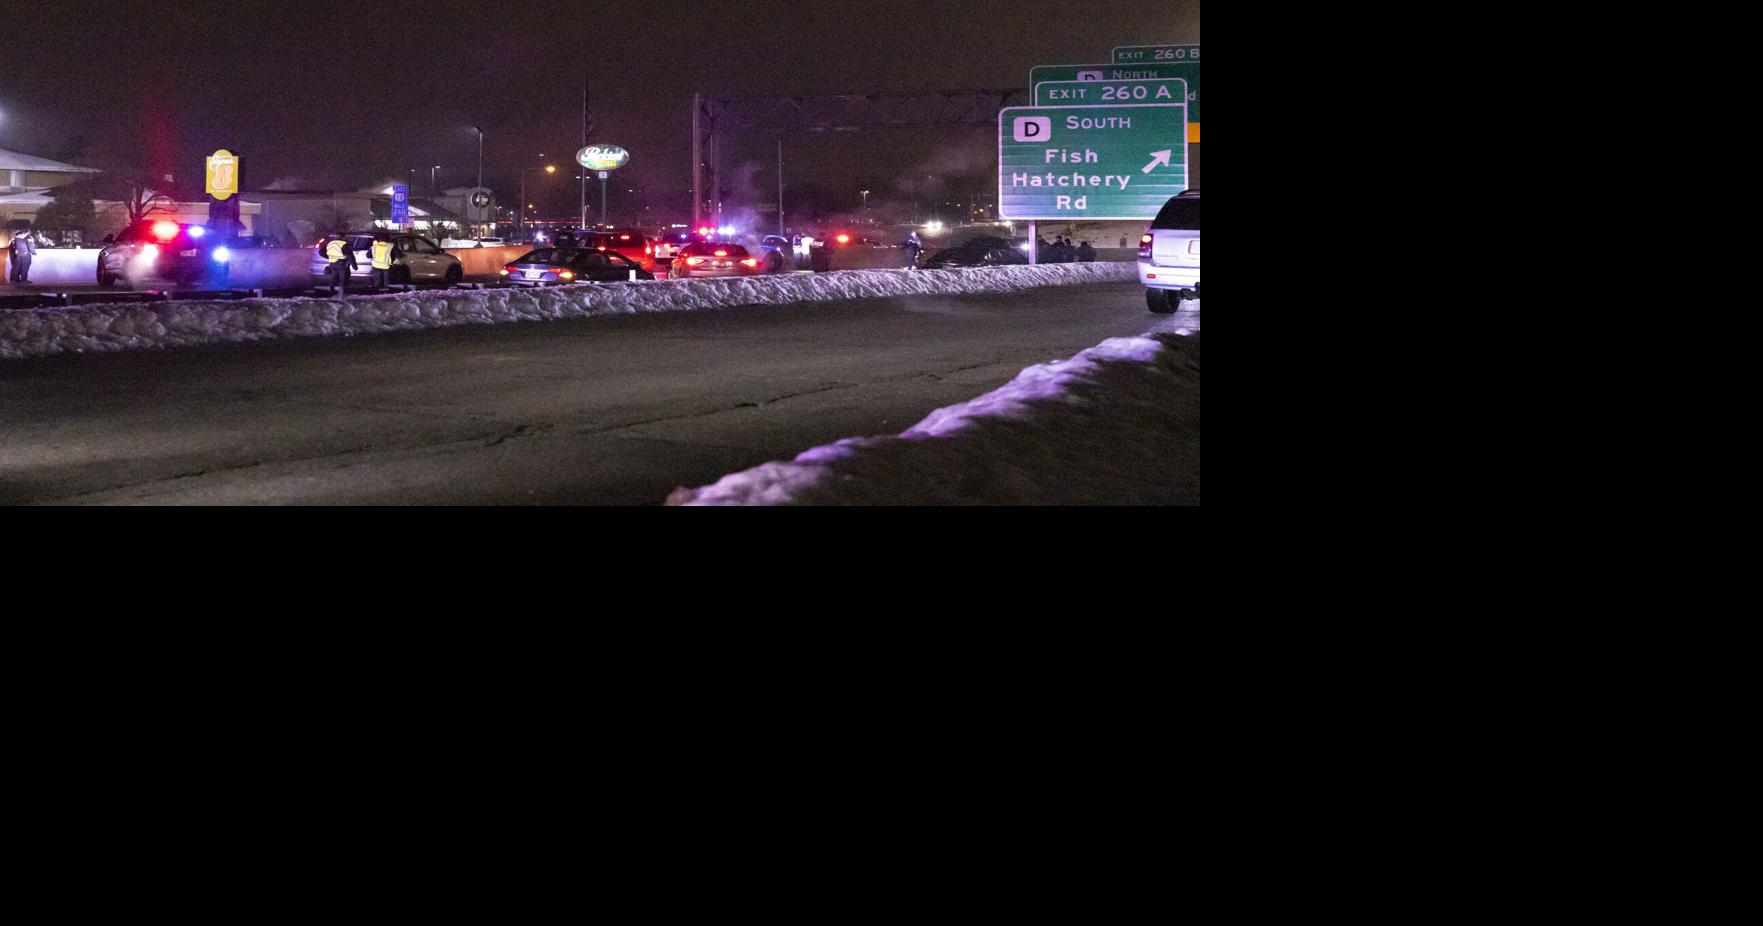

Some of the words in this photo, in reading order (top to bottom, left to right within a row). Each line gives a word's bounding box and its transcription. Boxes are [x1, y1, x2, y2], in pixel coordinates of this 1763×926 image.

[1118, 51, 1144, 60] EXIT
[1154, 48, 1186, 60] 260
[1190, 48, 1200, 59] B
[1049, 89, 1087, 99] EXIT
[1101, 85, 1148, 100] 260
[1155, 85, 1172, 99] A
[1024, 121, 1040, 137] D
[1045, 149, 1098, 163] Fish
[1012, 172, 1130, 190] Hatchery
[1056, 195, 1087, 210] Rd
